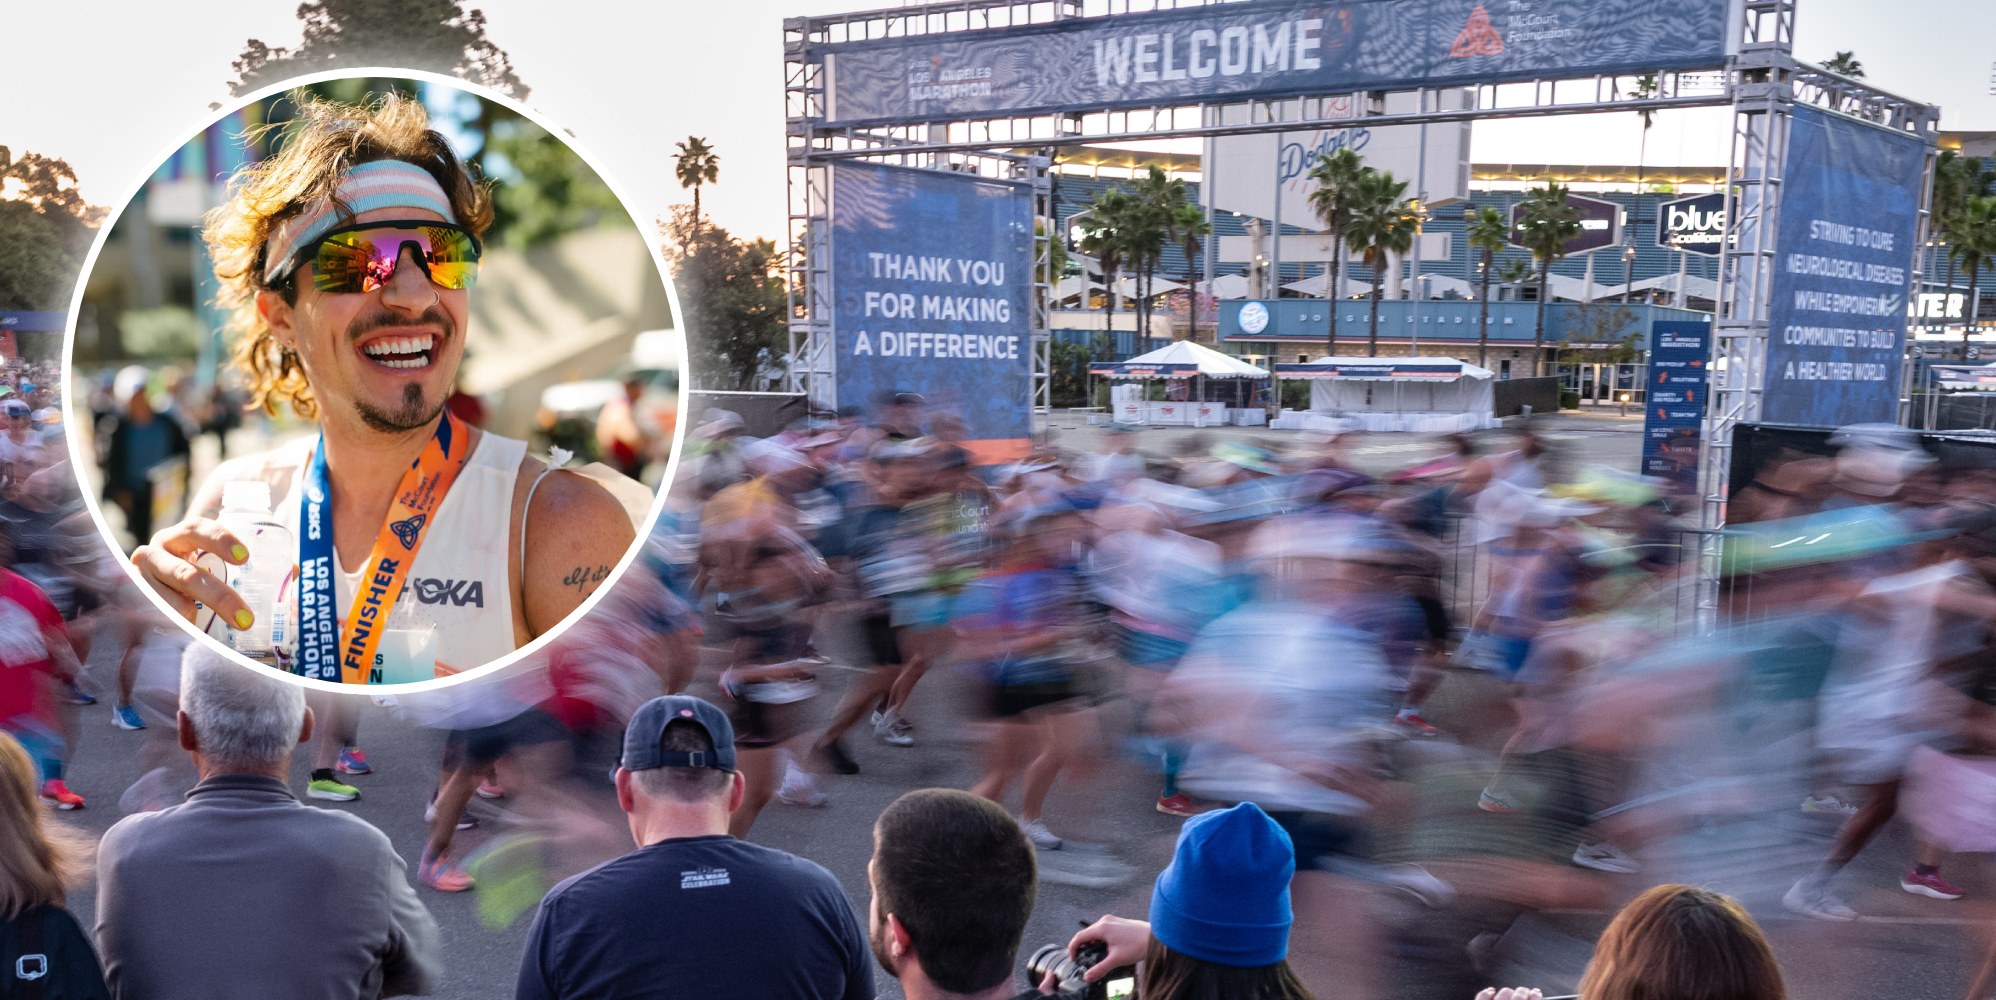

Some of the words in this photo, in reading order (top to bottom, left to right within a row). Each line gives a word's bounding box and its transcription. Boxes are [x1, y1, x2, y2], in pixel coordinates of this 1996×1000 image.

[1507, 28, 1571, 42] Foundation
[1094, 18, 1324, 87] WELCOME
[908, 82, 992, 101] MARATHON
[1668, 204, 1727, 231] blue
[1810, 219, 1855, 245] STRIVING
[1855, 227, 1870, 247] TO
[1870, 230, 1895, 251] CURE
[868, 252, 952, 283] THANK
[957, 258, 1005, 286] YOU
[1786, 253, 1864, 281] NEUROLOGICAL
[865, 291, 915, 319] FOR
[922, 295, 1011, 323] MAKING
[1795, 290, 1833, 312] WHILE
[853, 330, 874, 356] A
[880, 331, 1019, 359] DIFFERENCE
[1784, 325, 1857, 348] COMMUNITIES
[1857, 329, 1870, 348] TO
[1870, 329, 1896, 349] BUILD
[1784, 361, 1796, 380] A
[316, 556, 330, 591] LOS
[302, 559, 320, 680] MARATHON
[344, 557, 400, 670] FINISHER
[316, 594, 336, 679] ANGELES
